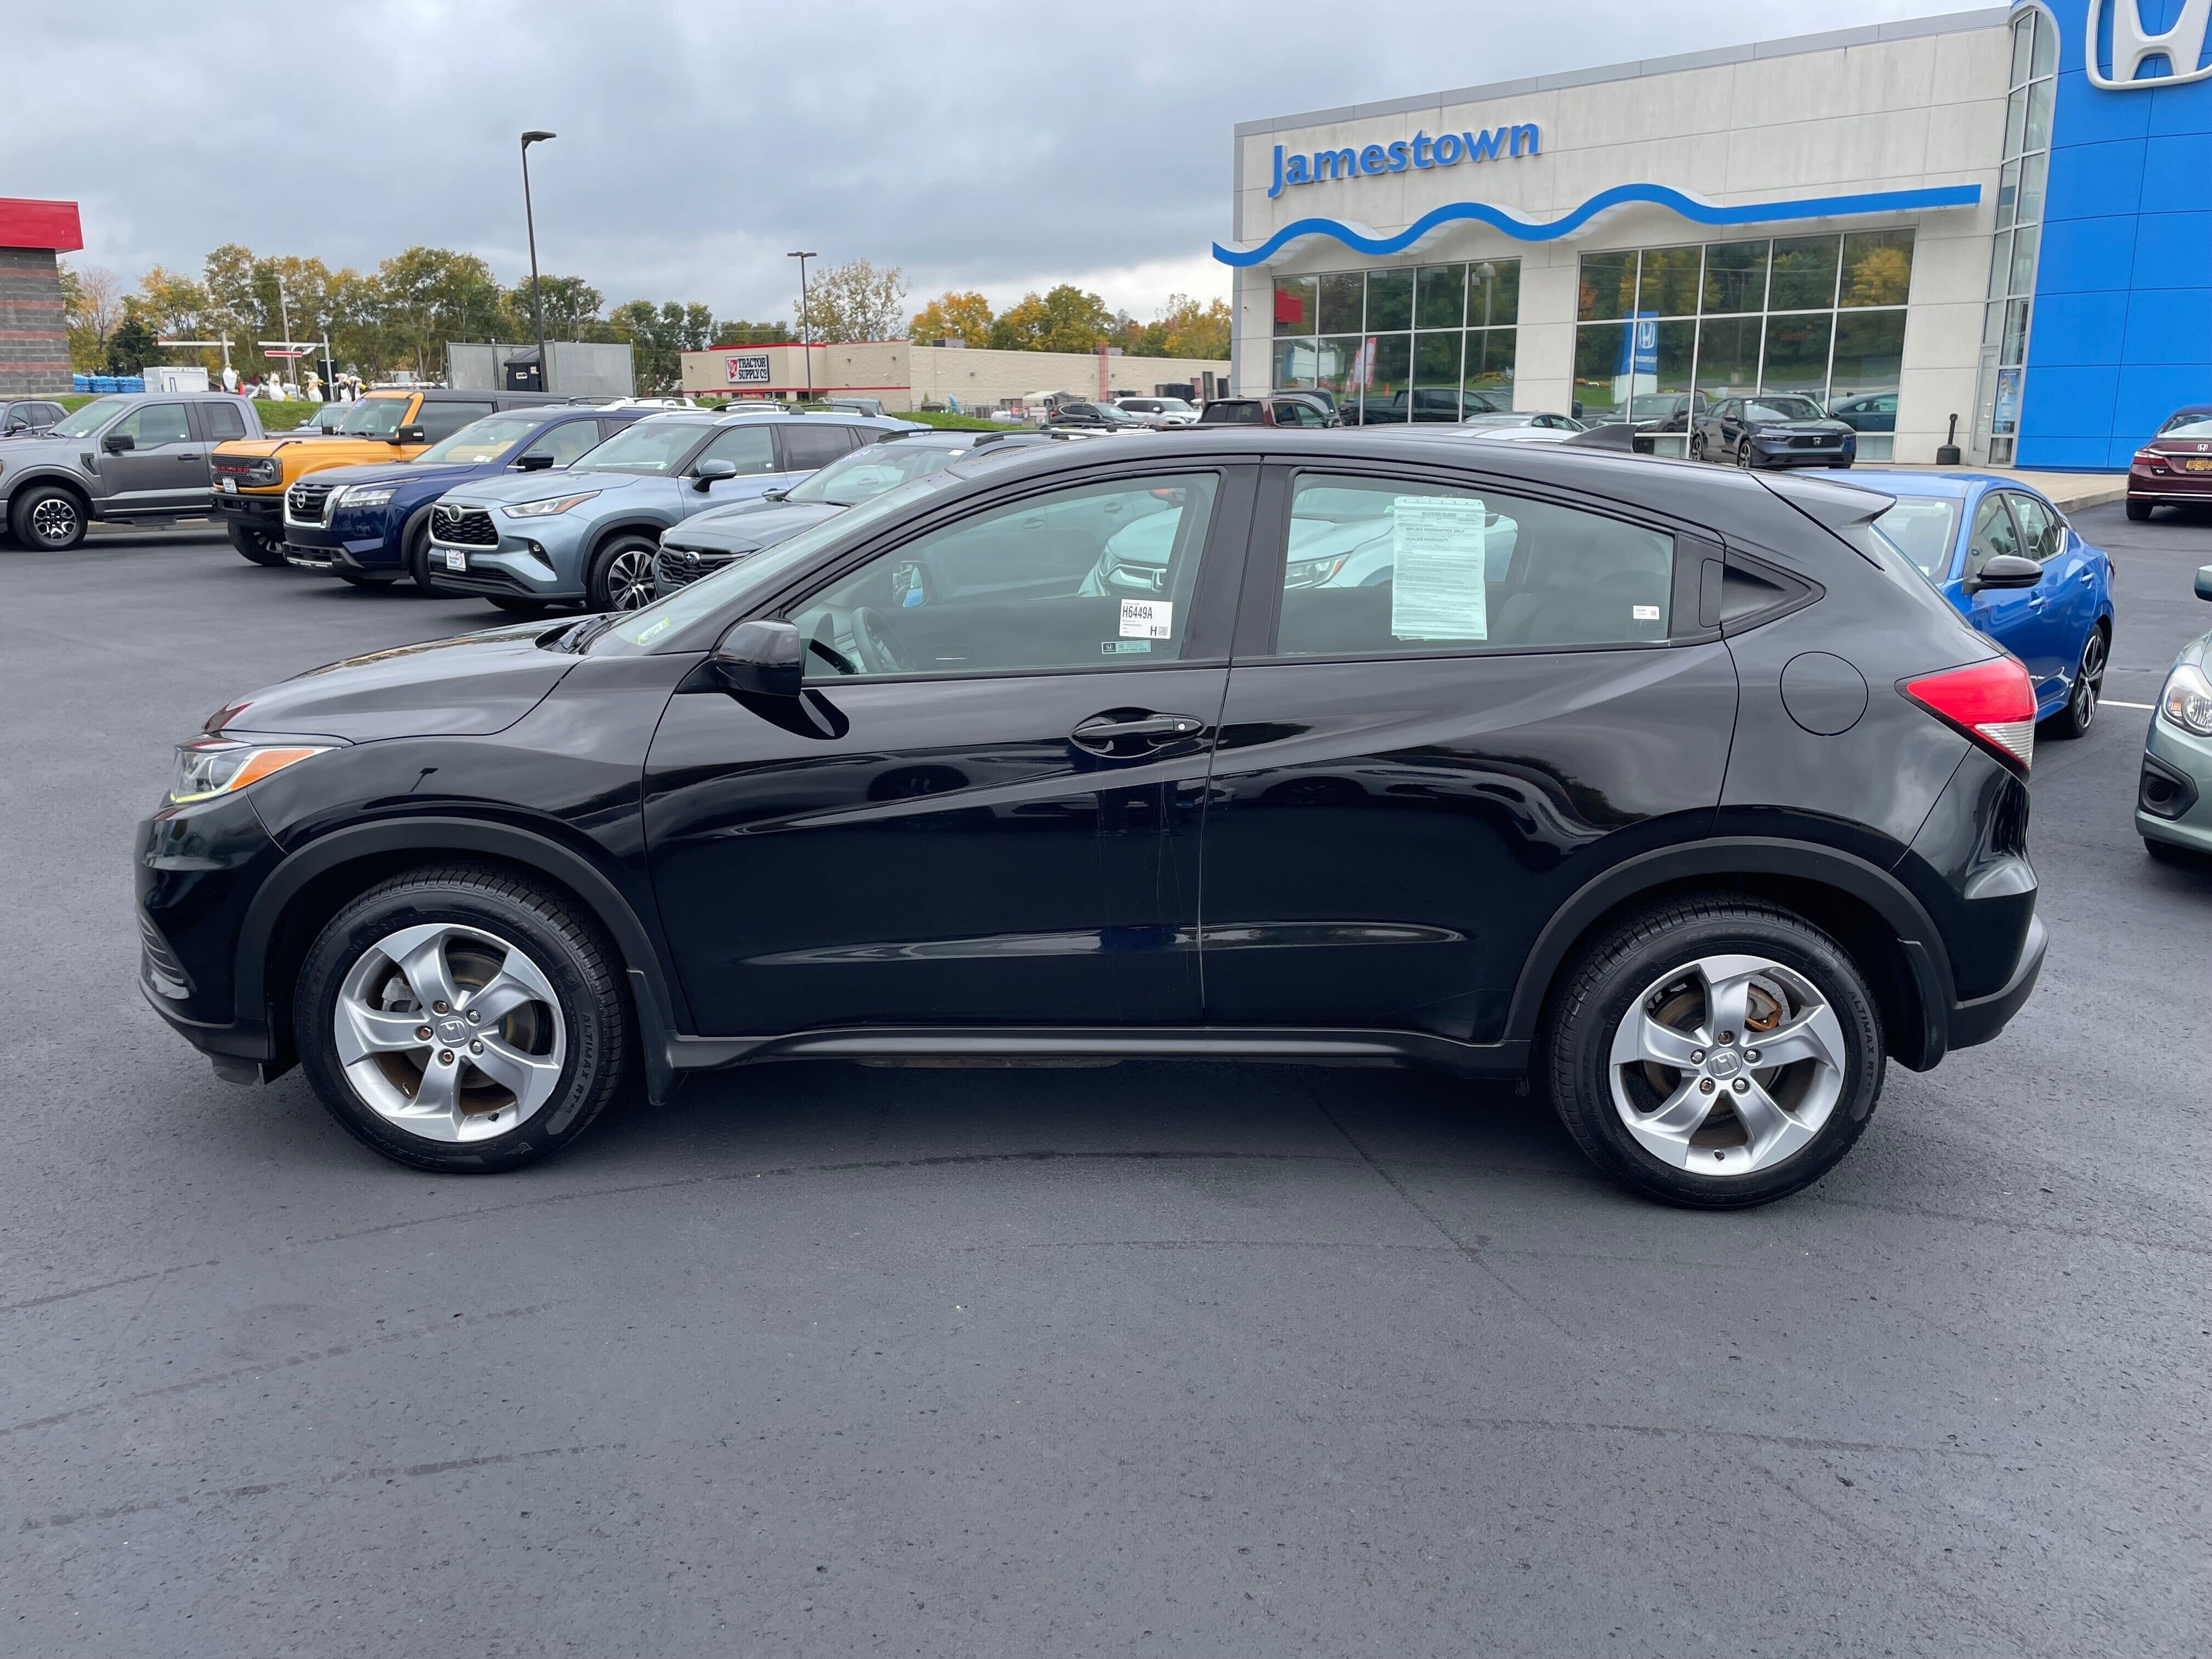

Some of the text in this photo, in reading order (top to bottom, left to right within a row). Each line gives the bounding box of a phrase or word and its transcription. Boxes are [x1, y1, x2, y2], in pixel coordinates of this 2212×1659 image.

[1268, 123, 1542, 199] Jamestown
[737, 358, 766, 368] TRACTOR
[738, 369, 760, 380] SUPPLY
[1122, 605, 1153, 619] H6449A
[1150, 625, 1157, 636] H
[1847, 991, 1875, 1054] ALTIMAX
[581, 1012, 594, 1080] ALTIMAX
